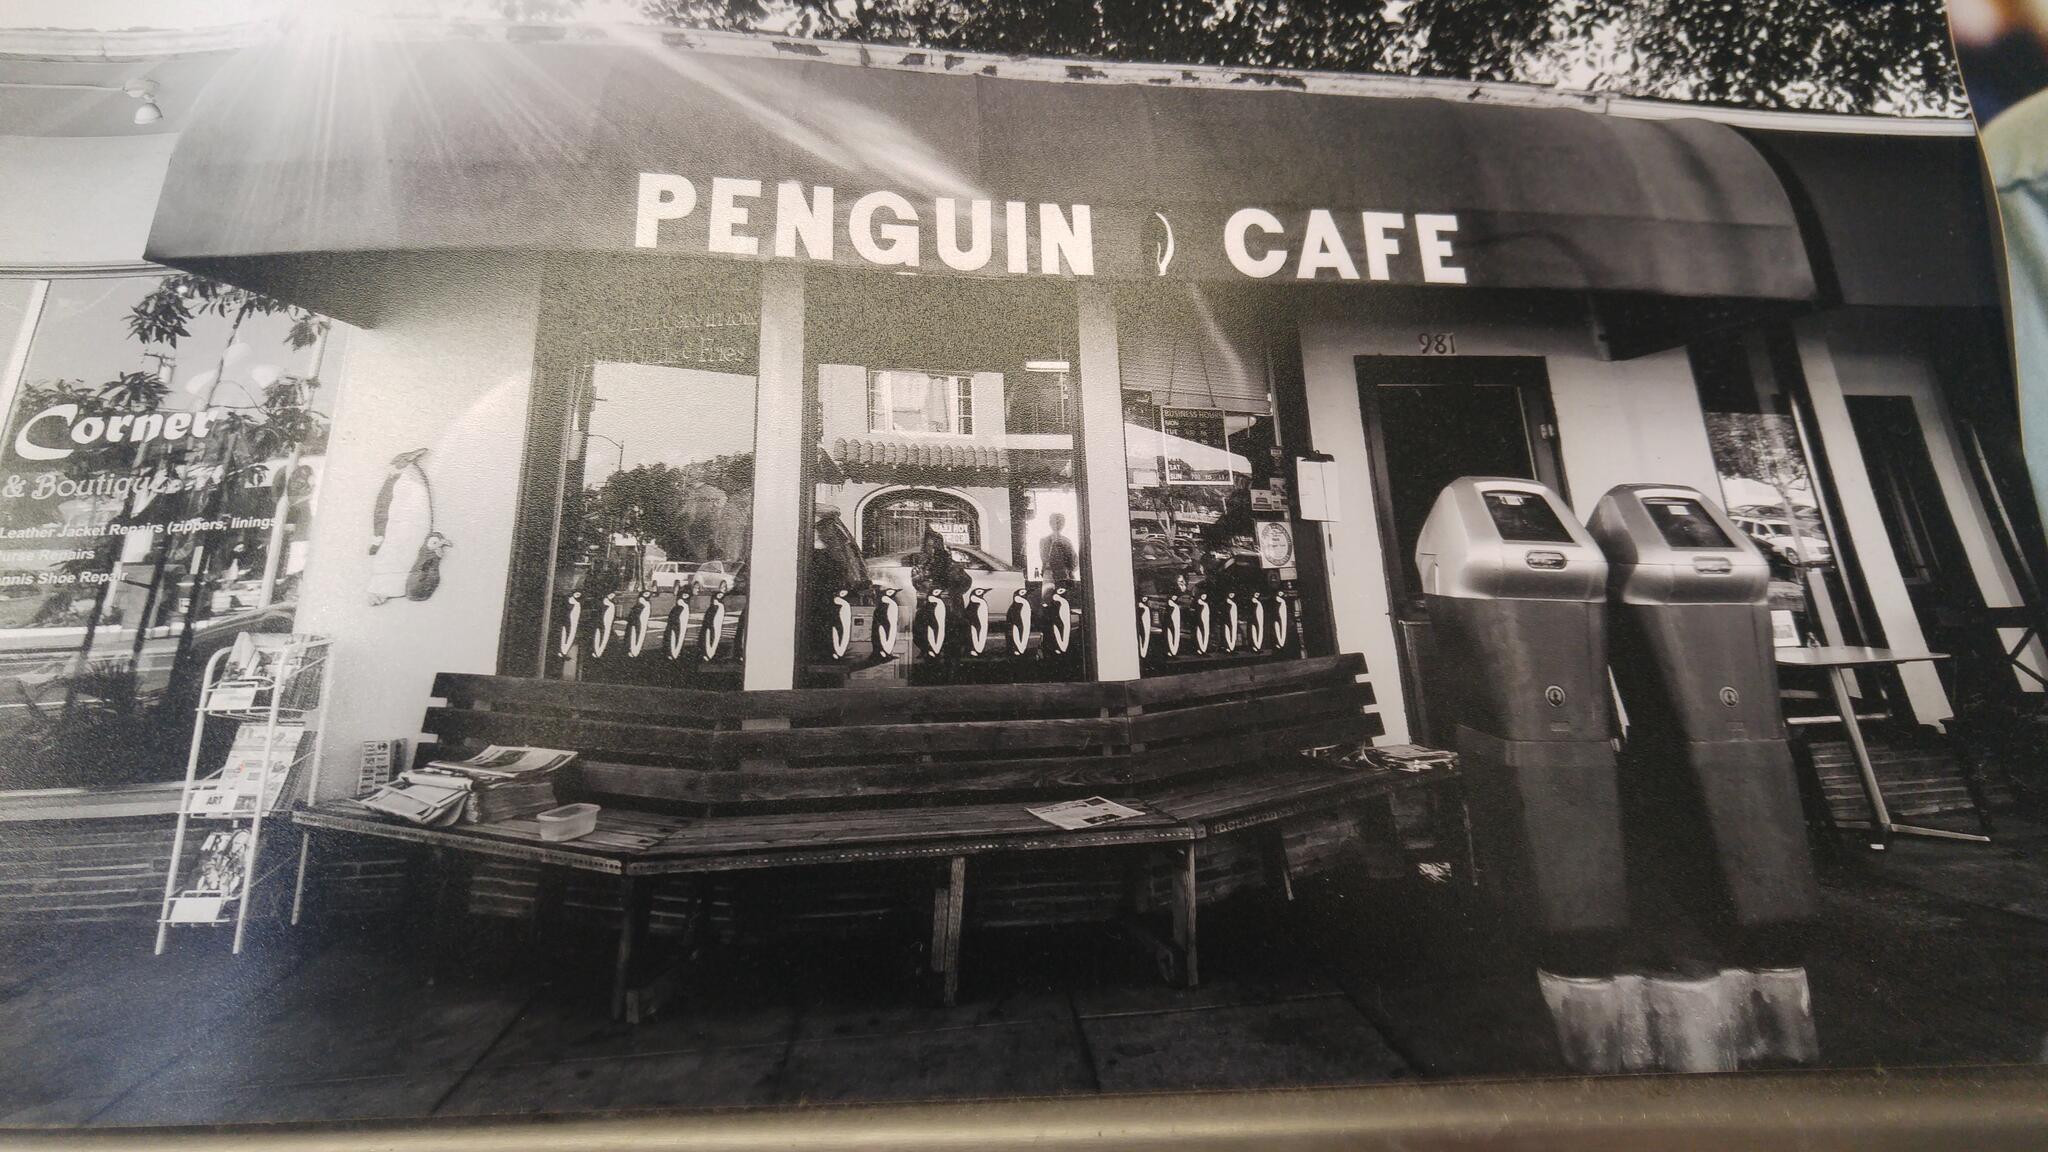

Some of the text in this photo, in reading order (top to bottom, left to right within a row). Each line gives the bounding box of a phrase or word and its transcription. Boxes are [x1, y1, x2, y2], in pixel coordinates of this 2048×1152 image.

[634, 171, 1468, 285] PENGUIN CAFE
[1417, 332, 1456, 355] 981
[14, 403, 219, 460] Corner
[2, 470, 184, 501] & Boutique
[0, 525, 57, 539] Leather
[56, 523, 107, 538] Jacket
[109, 520, 164, 536] Repairs
[38, 548, 96, 561] Repairs
[0, 570, 129, 586] nnis Shoe Repair
